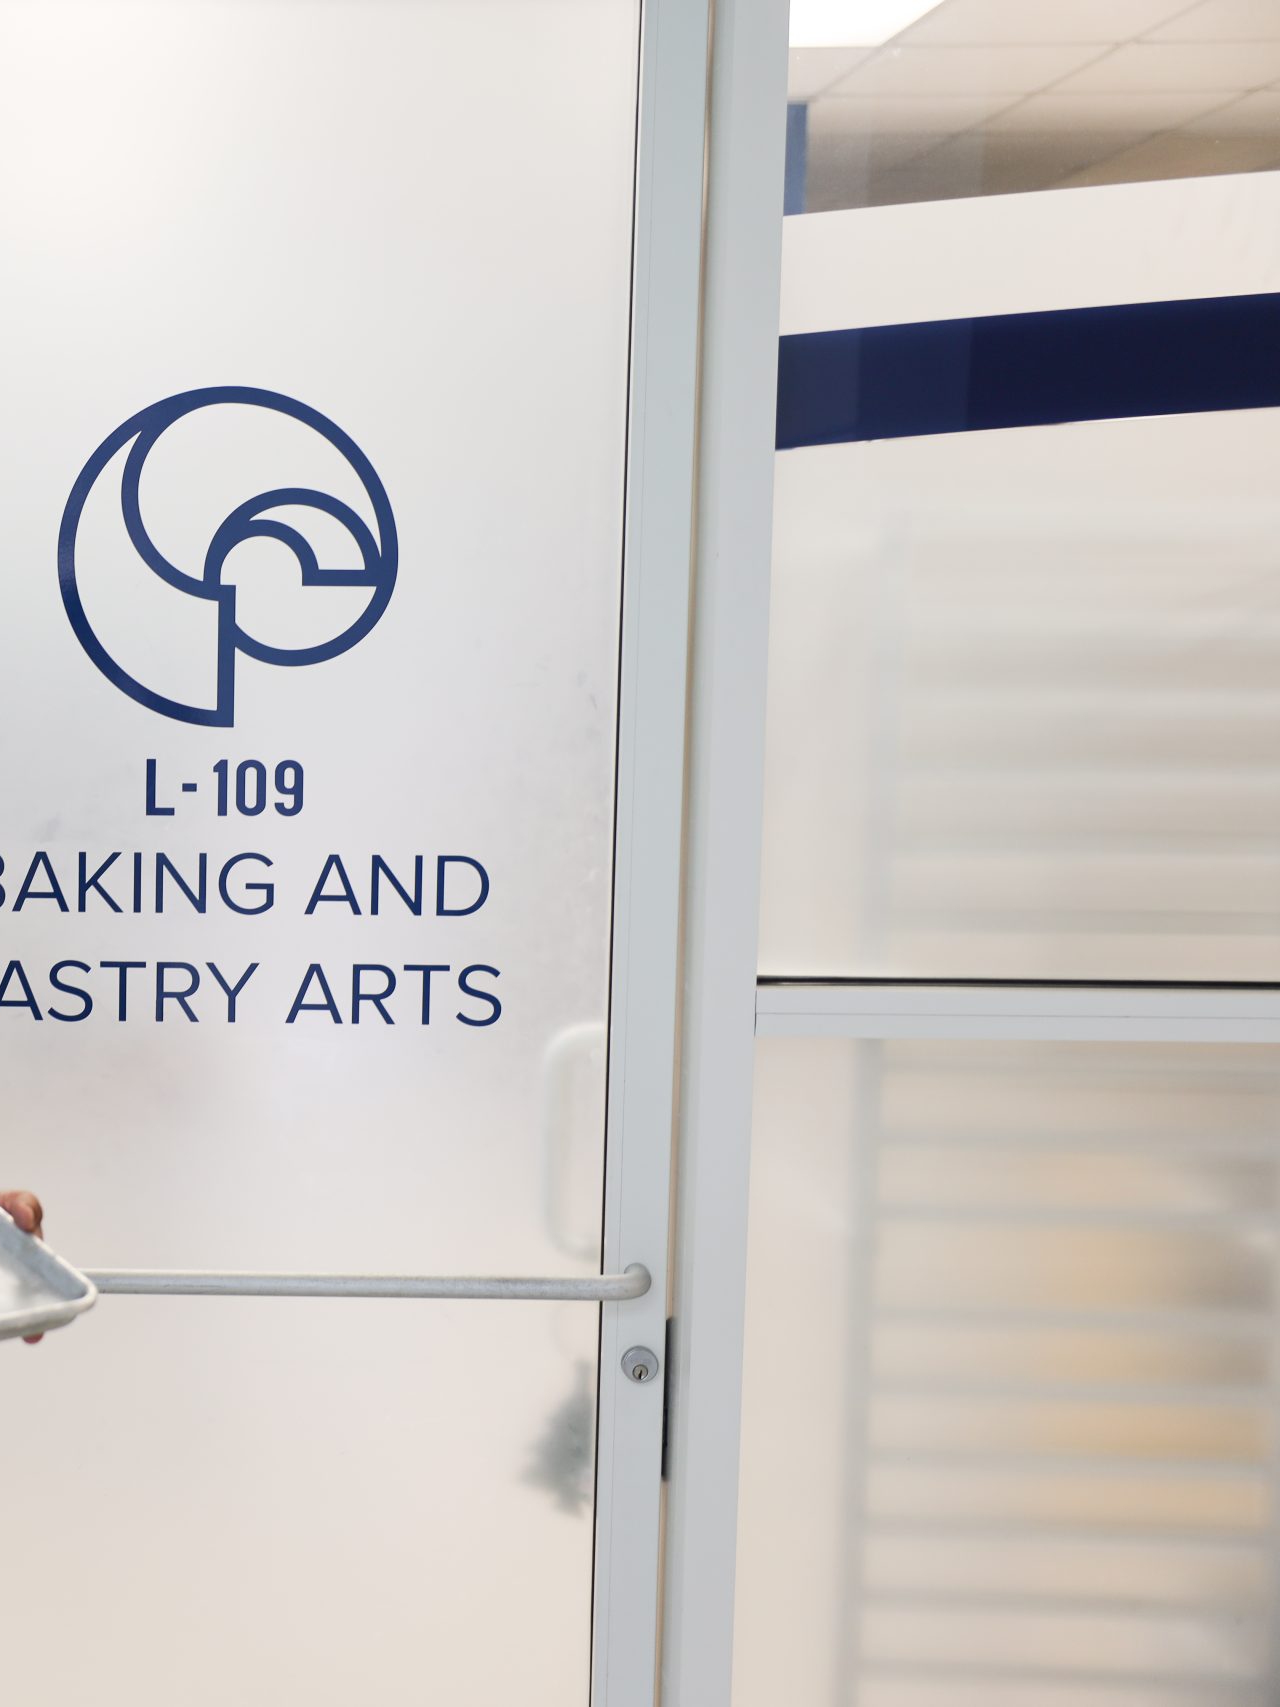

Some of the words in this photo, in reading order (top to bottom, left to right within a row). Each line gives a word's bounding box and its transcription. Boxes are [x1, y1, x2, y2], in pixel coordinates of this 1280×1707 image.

[145, 758, 304, 817] L-109
[304, 854, 490, 917] AND
[285, 963, 502, 1027] ARTS
